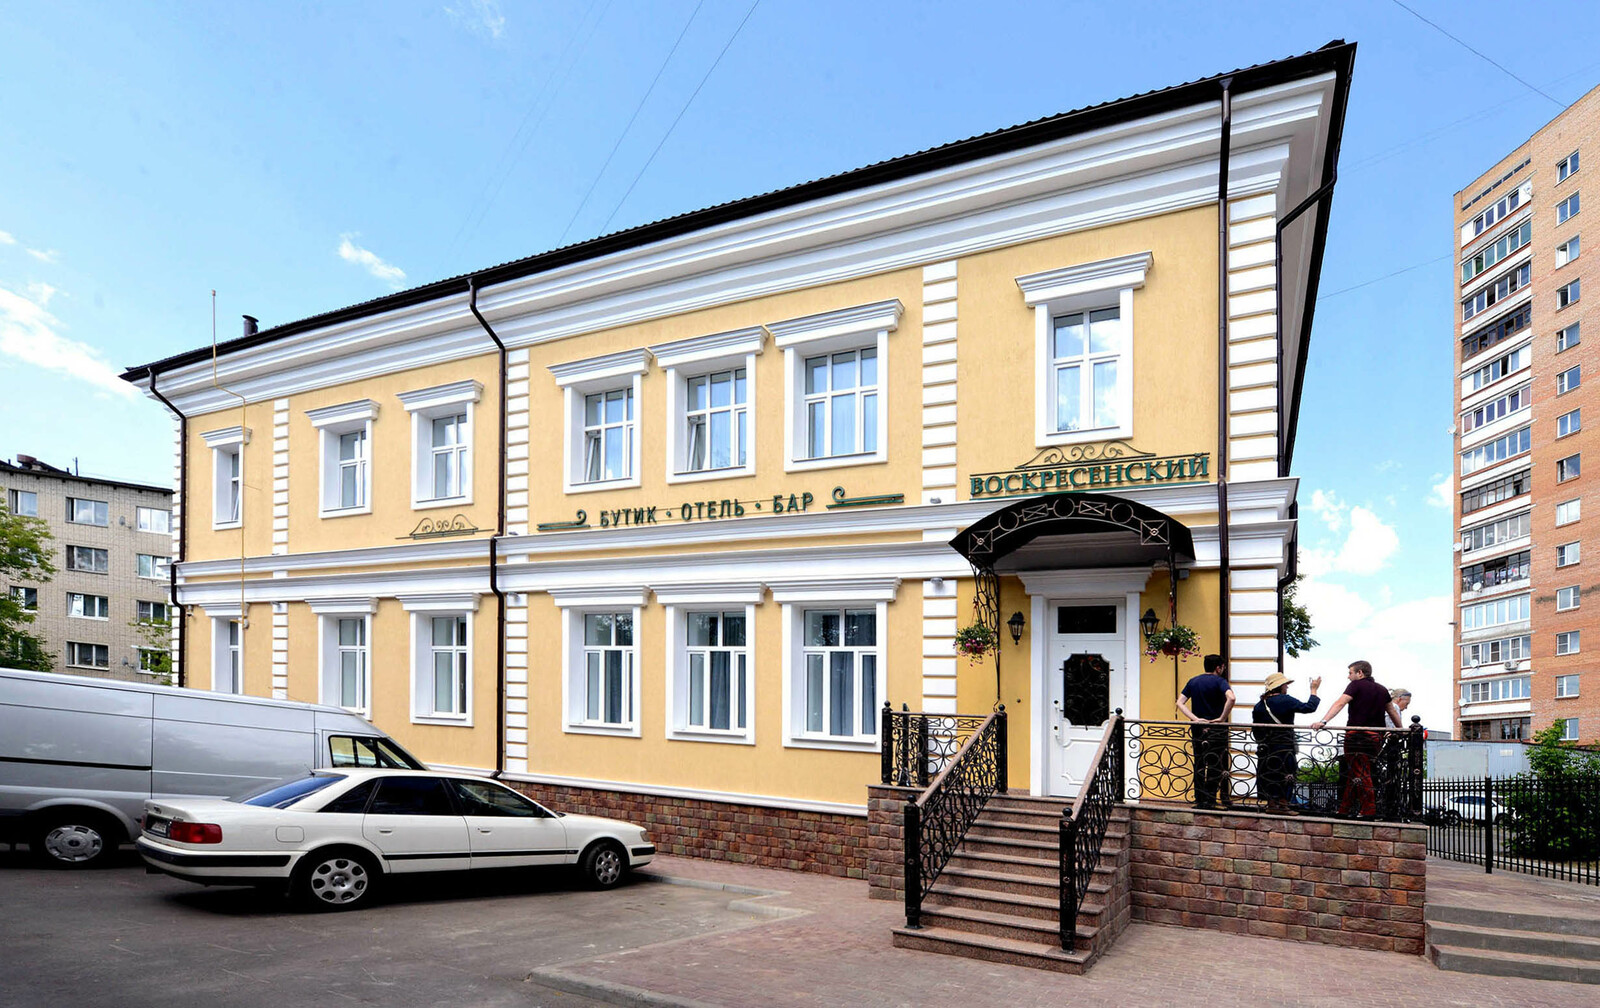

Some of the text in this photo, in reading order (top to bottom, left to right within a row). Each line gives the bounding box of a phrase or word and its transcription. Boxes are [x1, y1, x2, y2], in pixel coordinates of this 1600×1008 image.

[970, 453, 1210, 496] ВОСКРЕСЕНСКИЙ
[600, 492, 814, 527] БУТИК ОТЕЛЬ БАР
